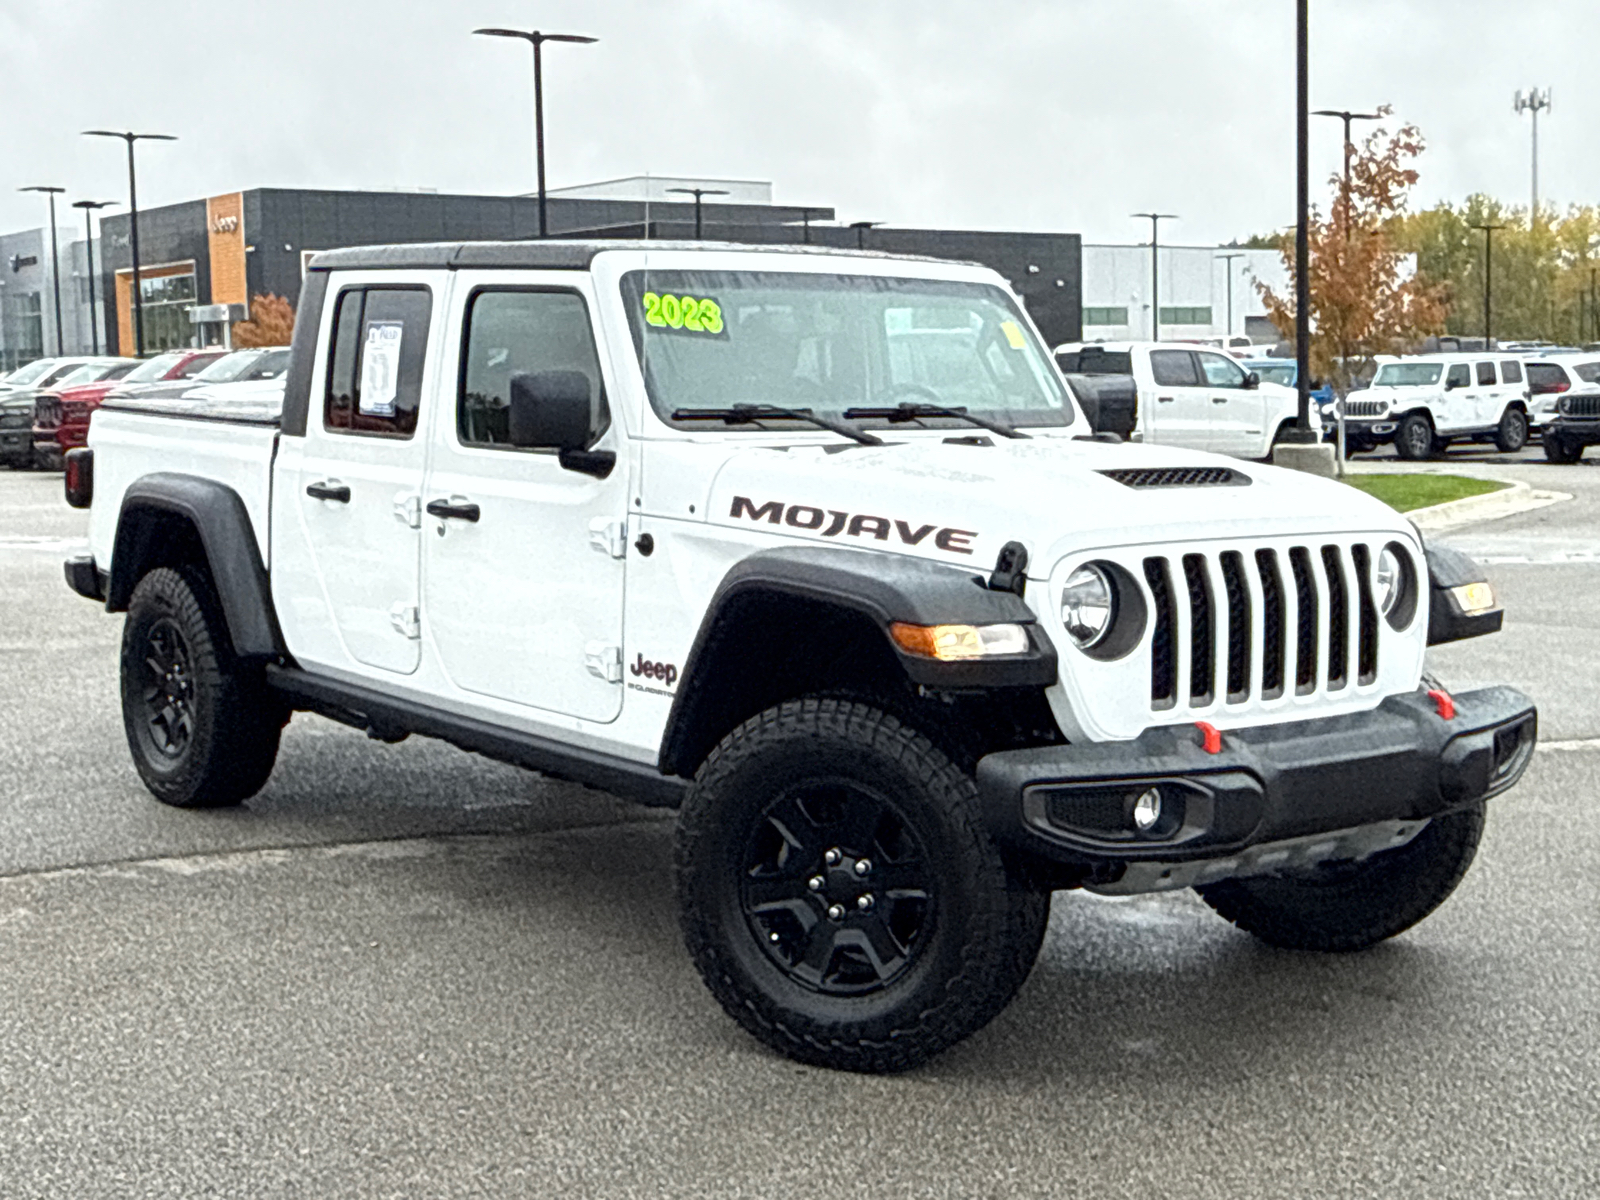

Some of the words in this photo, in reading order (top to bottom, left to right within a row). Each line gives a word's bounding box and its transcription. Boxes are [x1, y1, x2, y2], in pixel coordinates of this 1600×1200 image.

[643, 292, 723, 334] 2023
[729, 495, 979, 555] MOJAVE
[630, 651, 677, 687] Jeep
[635, 684, 675, 698] GLADIATO
